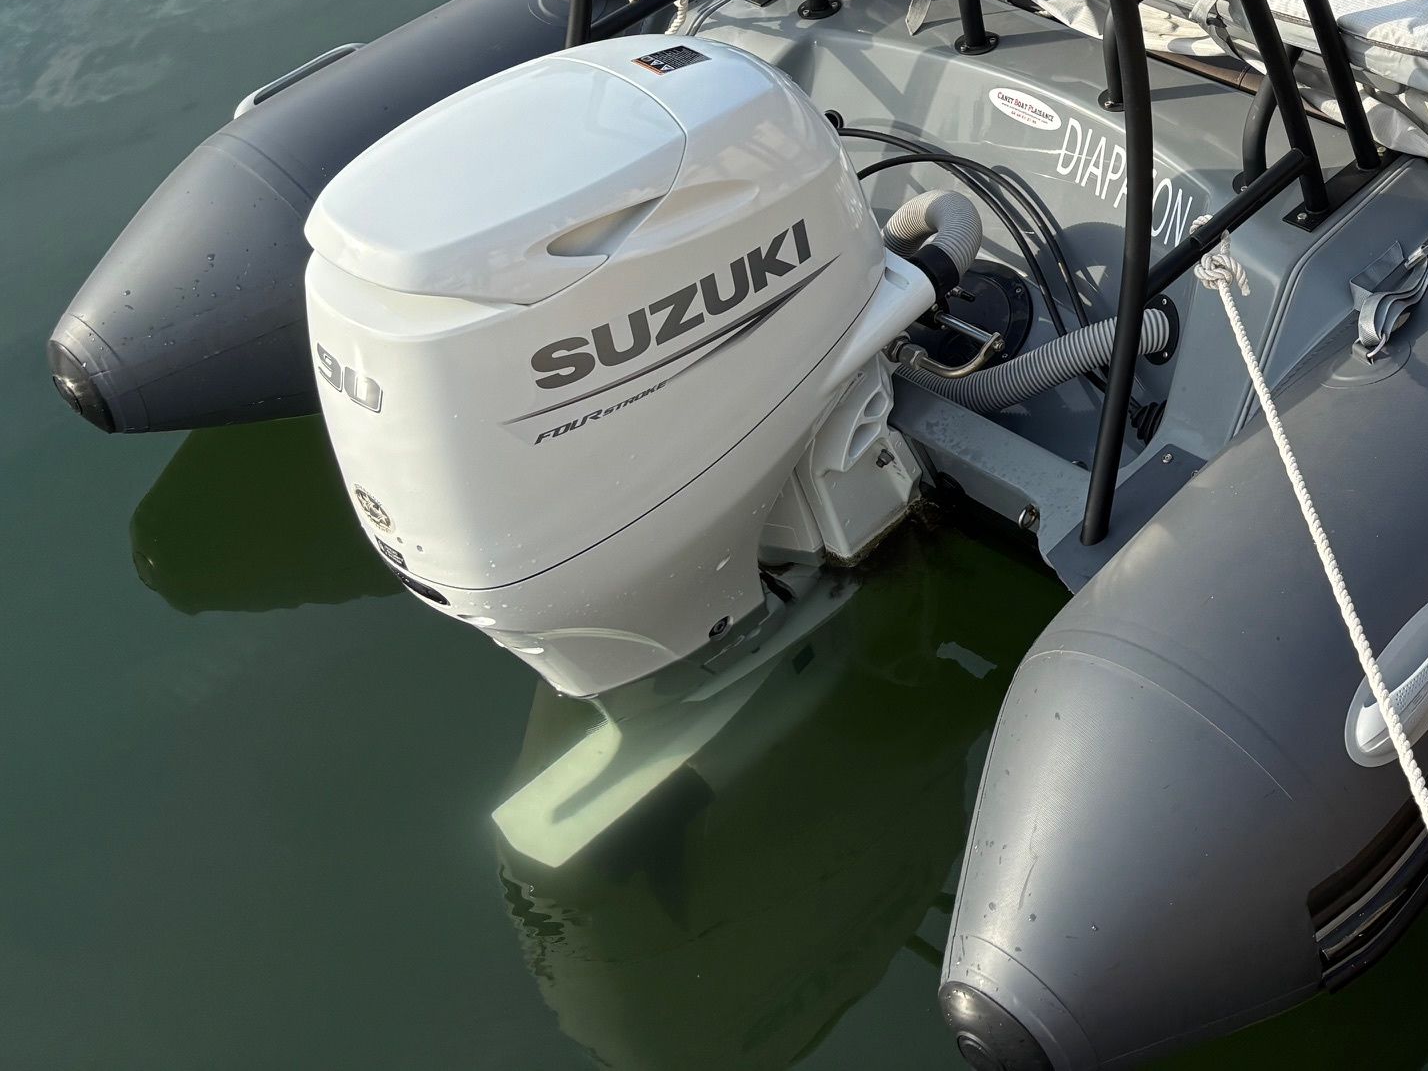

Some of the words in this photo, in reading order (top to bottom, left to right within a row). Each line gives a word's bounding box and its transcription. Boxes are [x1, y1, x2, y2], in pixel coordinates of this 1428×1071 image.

[1056, 117, 1193, 248] DIAPON
[531, 218, 812, 390] SUZUKI
[316, 342, 384, 414] 90
